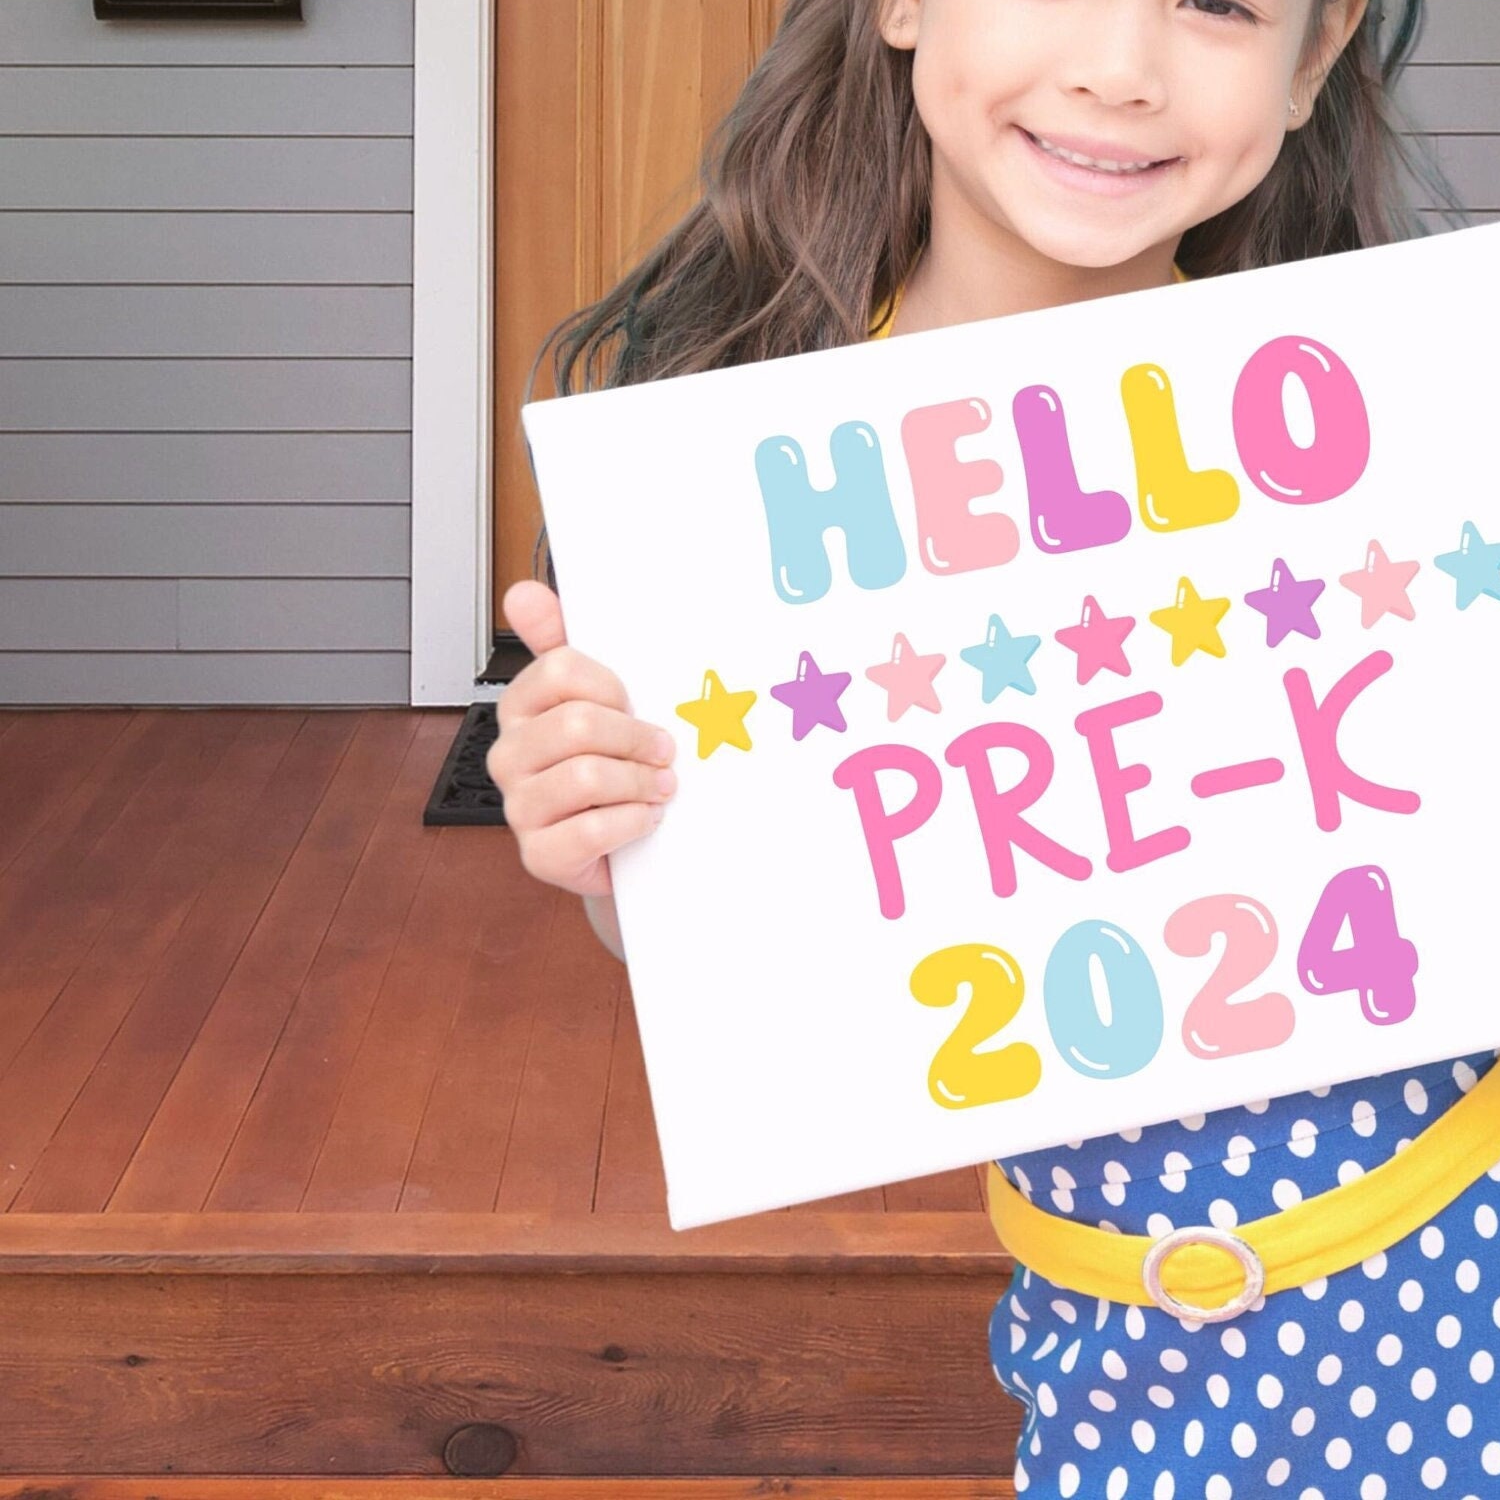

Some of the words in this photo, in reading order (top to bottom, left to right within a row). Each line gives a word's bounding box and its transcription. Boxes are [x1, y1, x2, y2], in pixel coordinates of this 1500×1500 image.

[756, 335, 1370, 604] HELLO
[832, 650, 1421, 920] PRE-K
[907, 865, 1420, 1111] 2024
